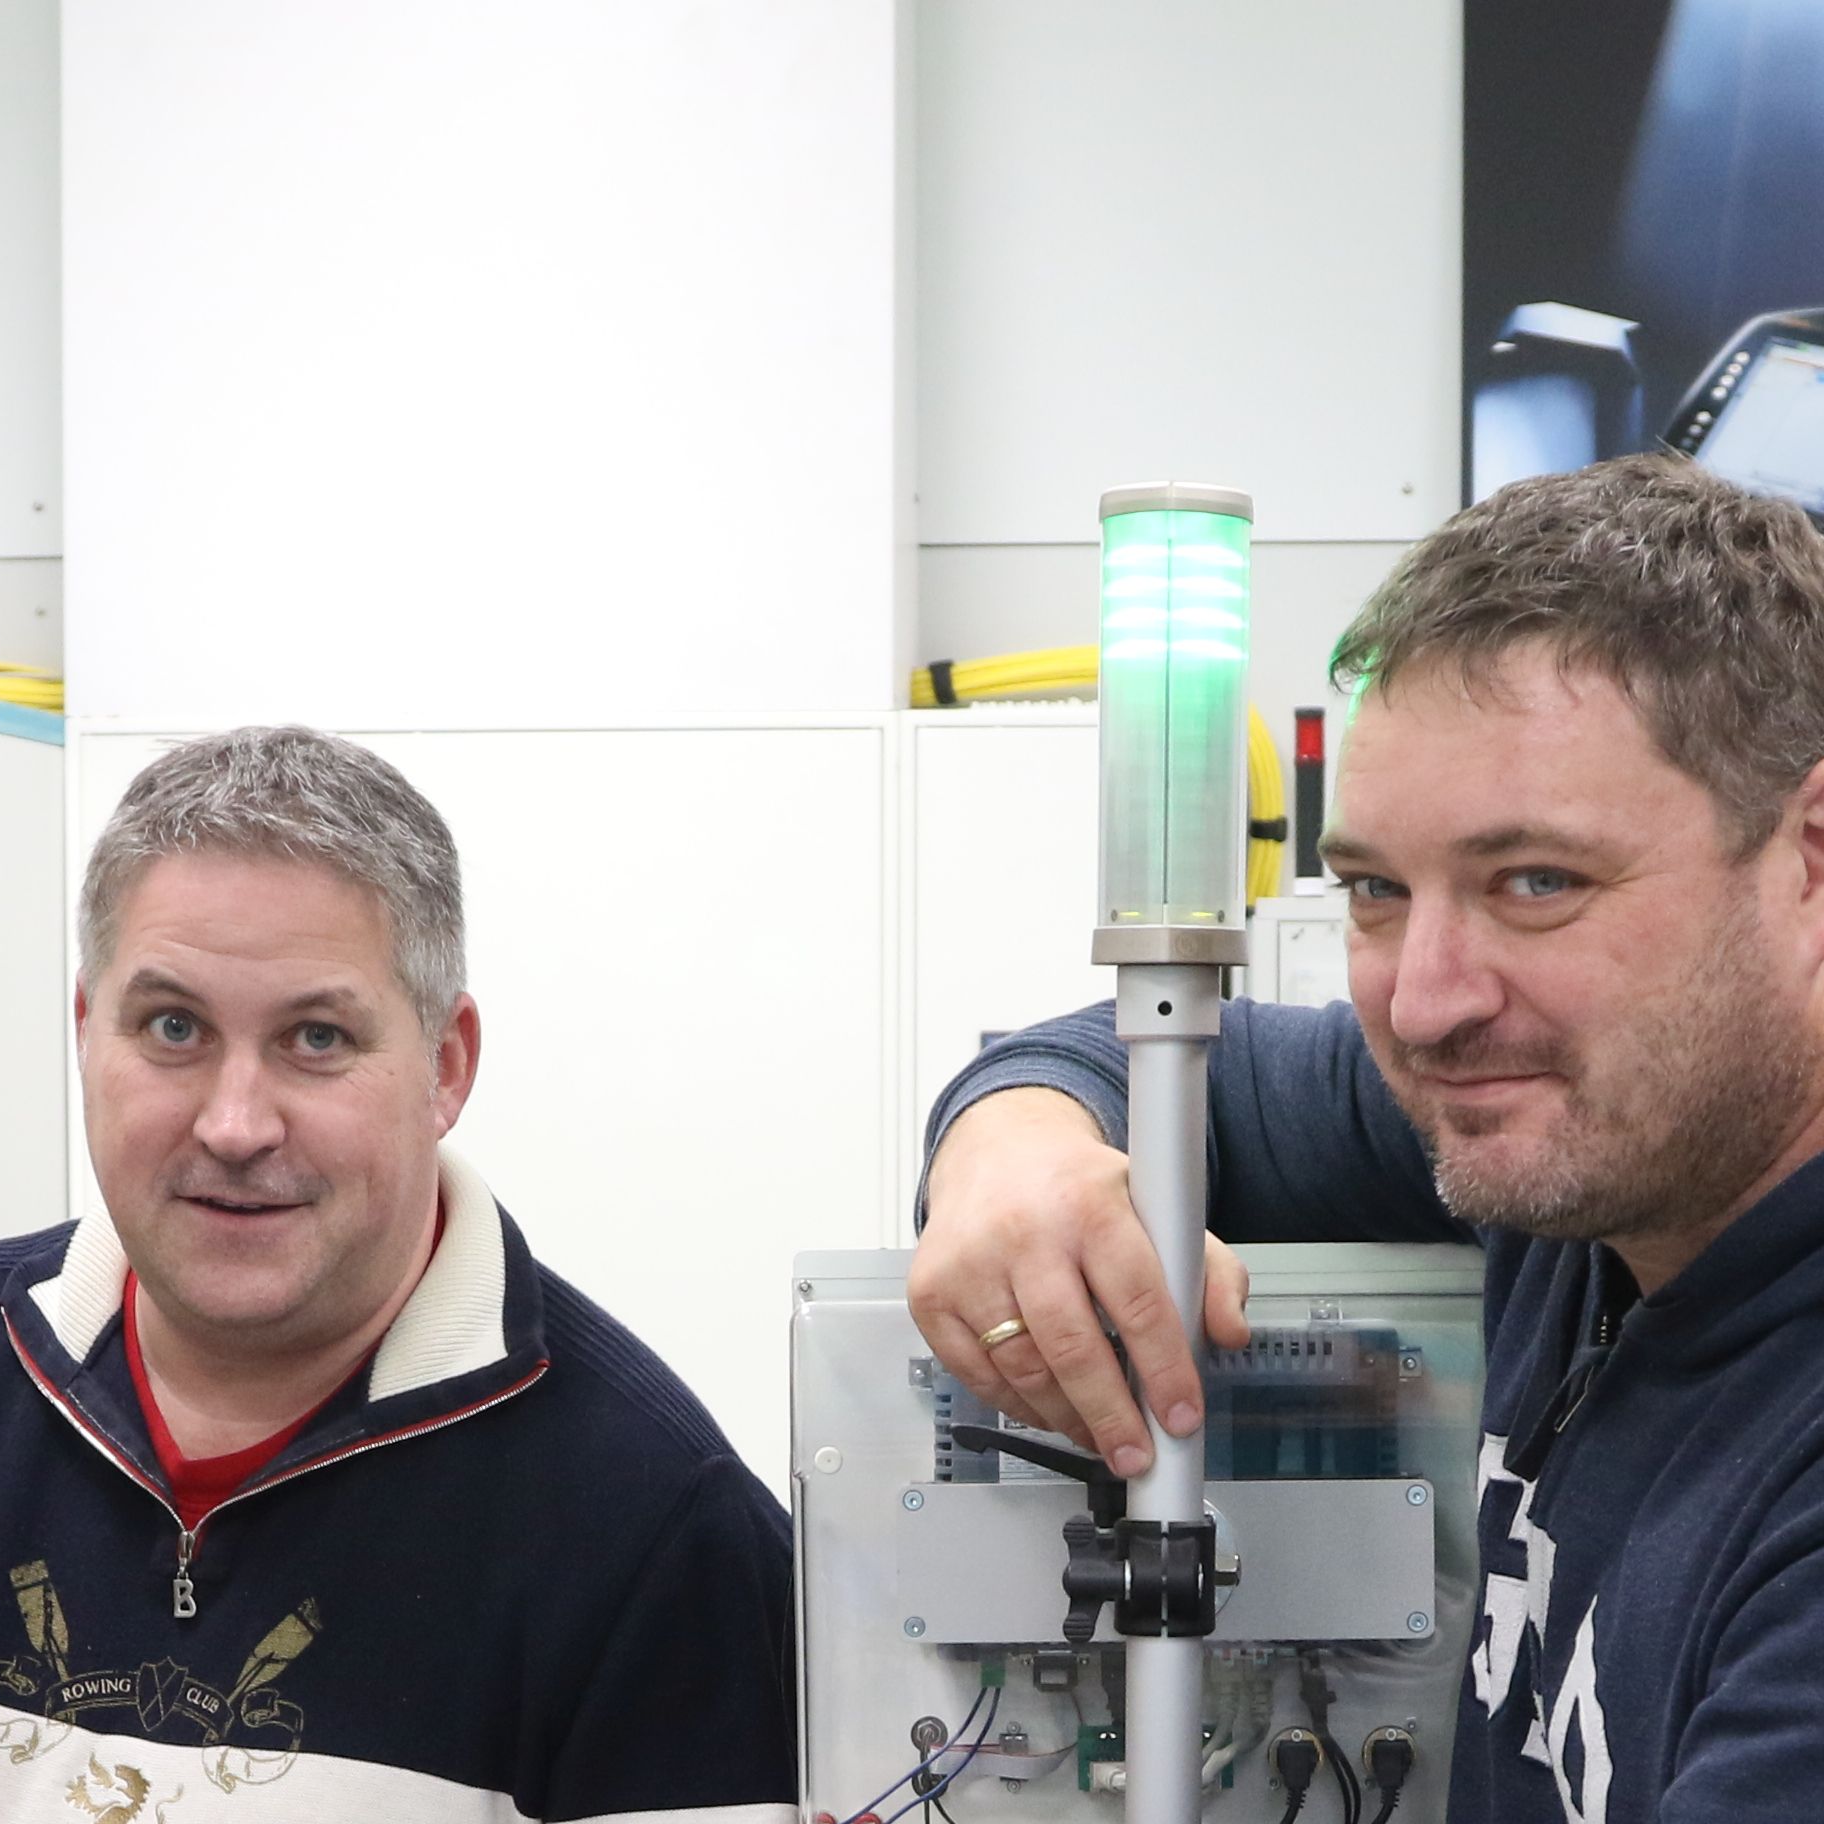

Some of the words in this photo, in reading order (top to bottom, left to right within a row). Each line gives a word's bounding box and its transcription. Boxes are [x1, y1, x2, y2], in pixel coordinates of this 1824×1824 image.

[173, 1579, 197, 1618] B
[61, 1678, 131, 1702] ROWING
[186, 1687, 221, 1714] CLUB
